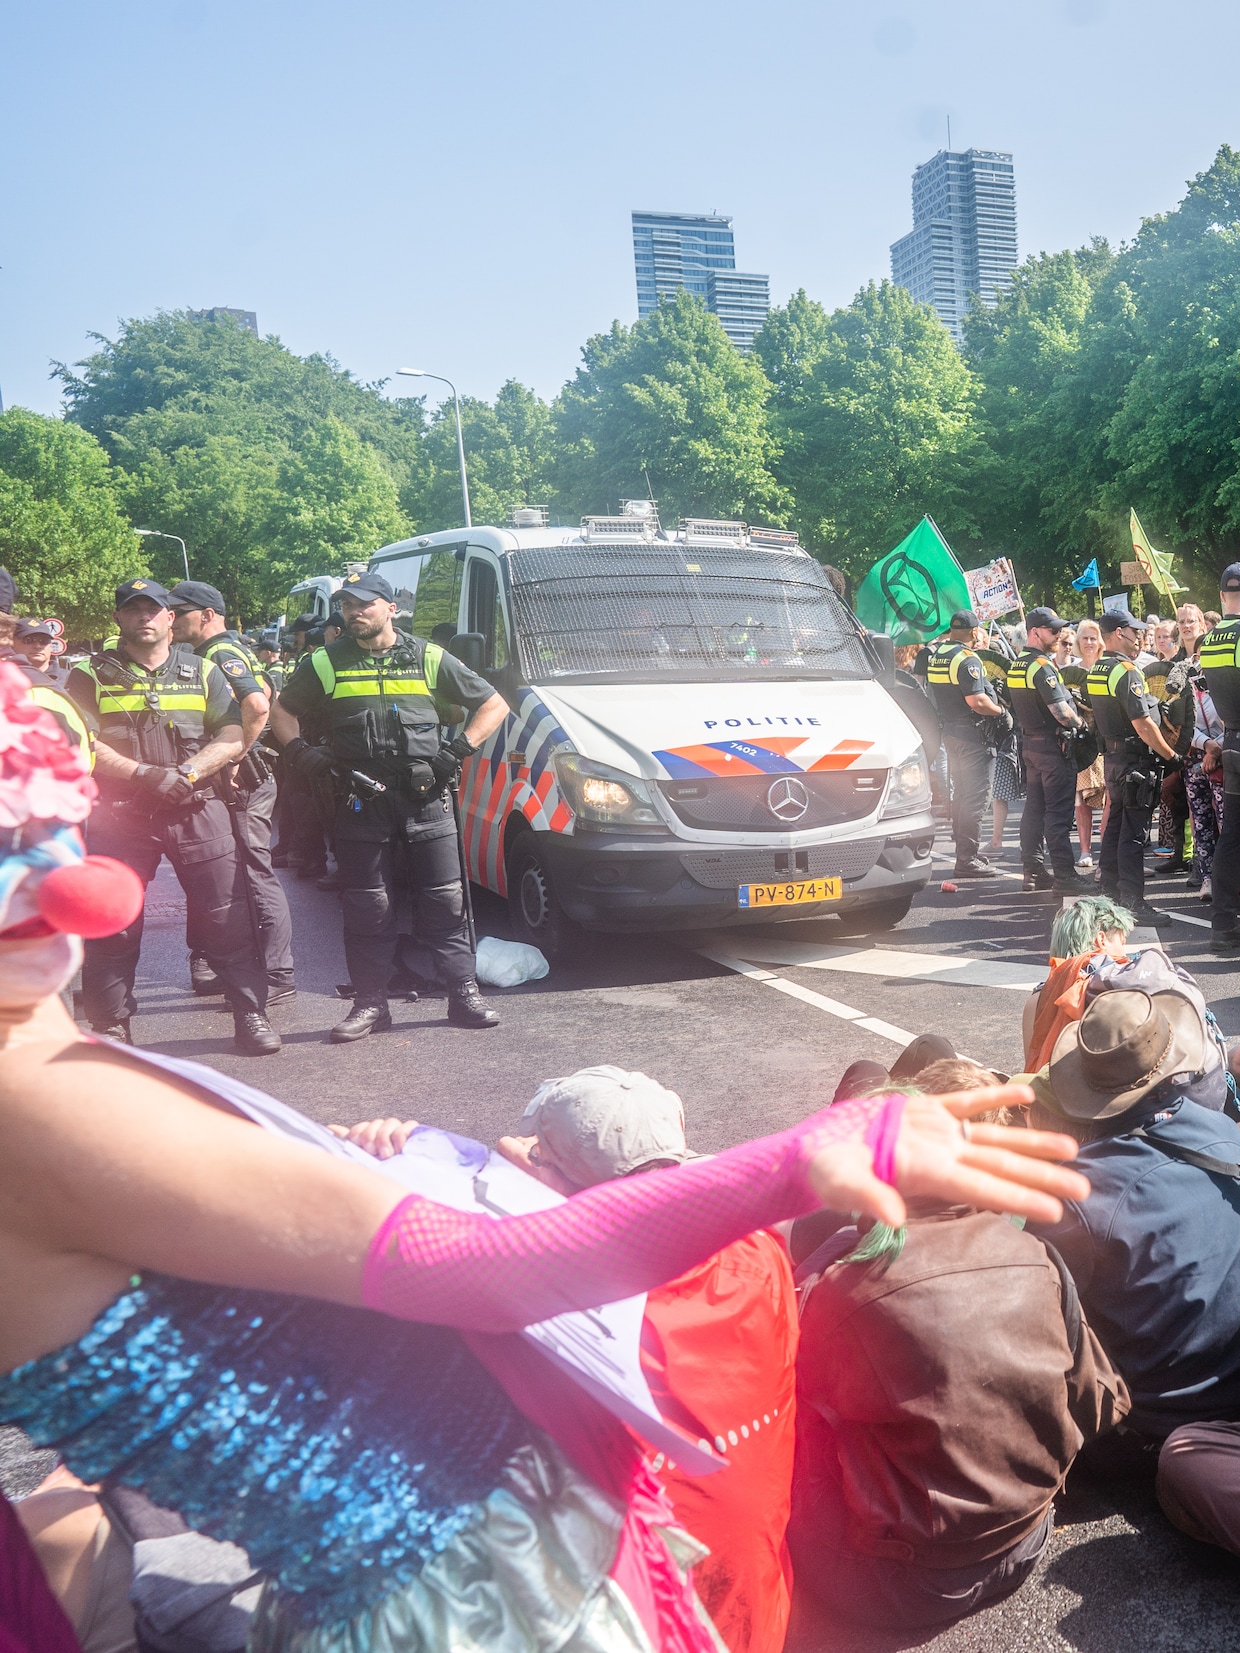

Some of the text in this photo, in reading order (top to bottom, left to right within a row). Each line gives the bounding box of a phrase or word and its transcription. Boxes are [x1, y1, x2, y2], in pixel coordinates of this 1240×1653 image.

[983, 582, 1008, 599] ACTION
[703, 716, 822, 729] POLITIE
[730, 742, 758, 757] 7402
[754, 880, 835, 903] PV-874-N
